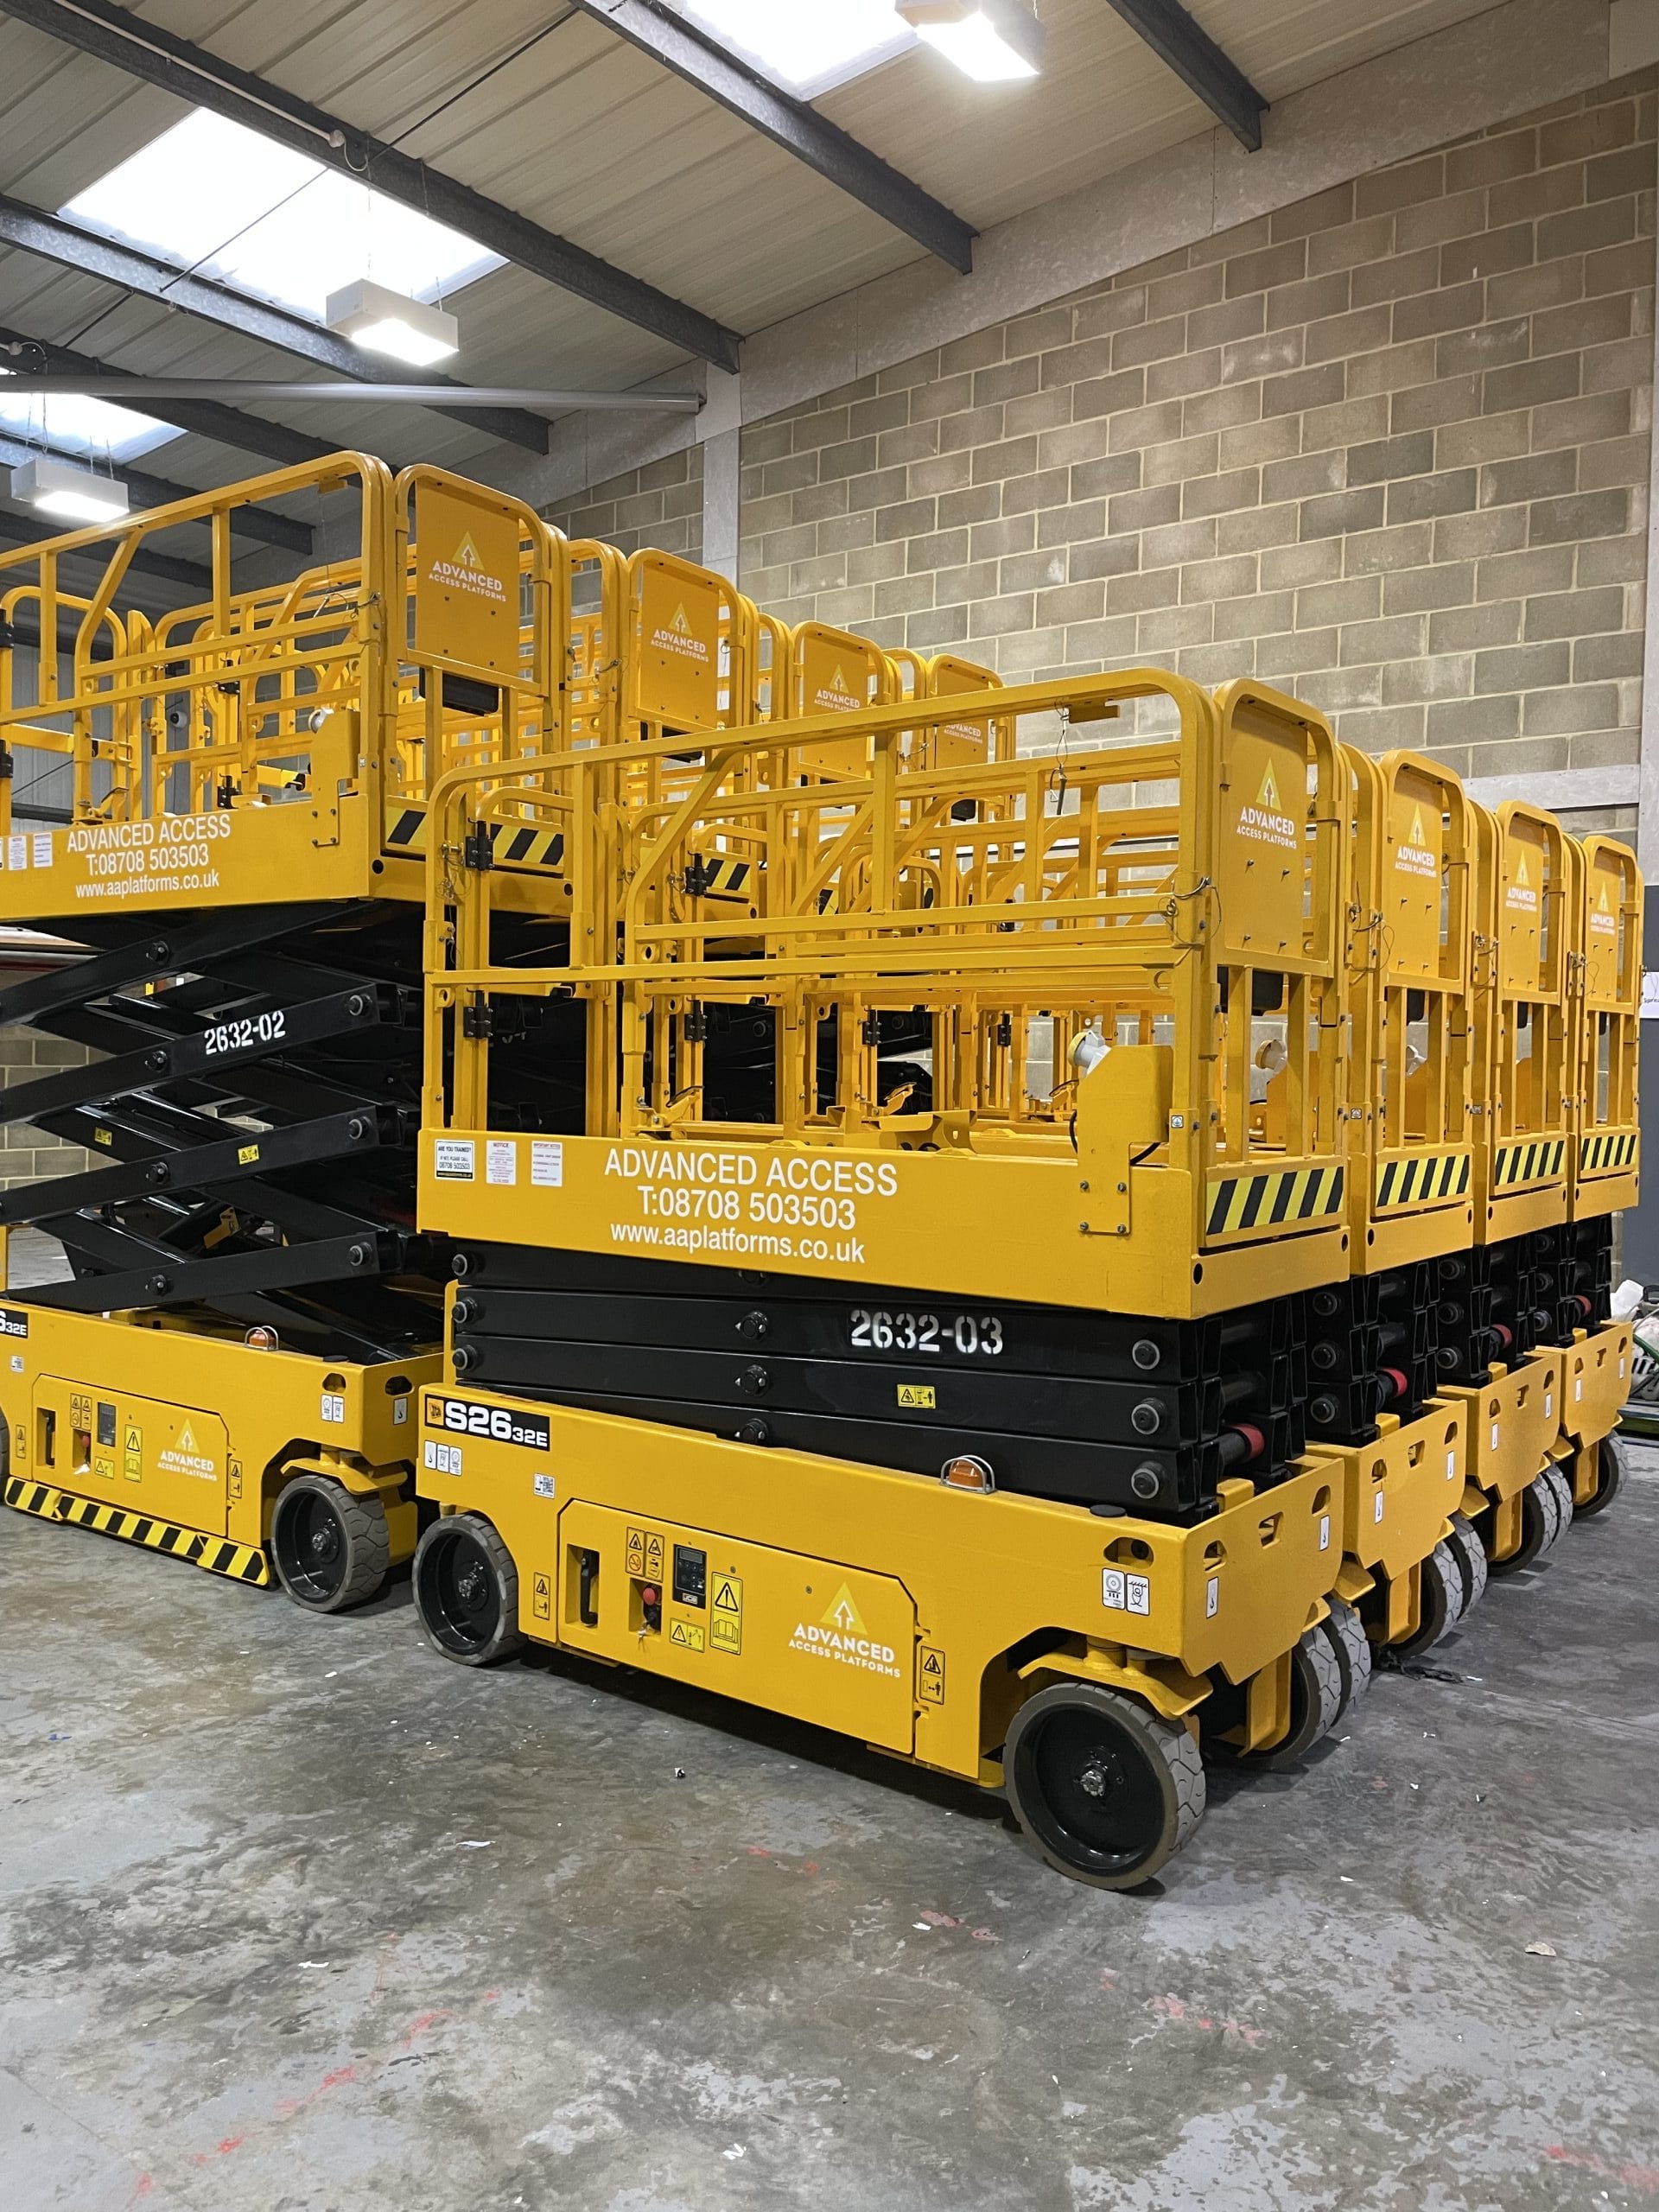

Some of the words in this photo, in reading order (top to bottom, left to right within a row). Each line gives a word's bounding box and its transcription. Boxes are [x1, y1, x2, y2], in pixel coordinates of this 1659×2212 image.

[429, 574, 460, 588] ACCESS
[462, 582, 506, 602] PLATFORMS
[432, 560, 503, 591] ADVANCED
[651, 639, 674, 652] ACCESS
[675, 646, 709, 663] PLATFORMS
[653, 629, 706, 653] ADVANCED
[817, 689, 861, 709] ADVANCED
[67, 822, 154, 853] ADVANCED
[159, 813, 231, 843] ACCESS
[1240, 805, 1294, 836] ADVANCED
[1236, 824, 1262, 840] ACCESS
[1263, 831, 1297, 849] PLATFORMS
[86, 850, 145, 876] T:08708
[149, 843, 209, 871] 503503
[1397, 845, 1435, 868] ADVANCED
[75, 868, 219, 899] www.aaplatforms.co.uk
[1507, 886, 1536, 903] ADVANCED
[204, 1010, 286, 1055] 2632-02
[604, 1147, 757, 1185] ADVANCED
[766, 1157, 898, 1196] ACCESS
[638, 1185, 740, 1220] T:08708
[749, 1192, 856, 1230] 503503
[611, 1223, 865, 1263] www.aaplatforms.co.uk
[850, 1309, 1003, 1355] 2632-03
[160, 1449, 214, 1471] ADVANCED
[793, 1622, 895, 1662] ADVANCED
[788, 1638, 831, 1657] ACCESS
[834, 1650, 901, 1678] PLATFORMS
